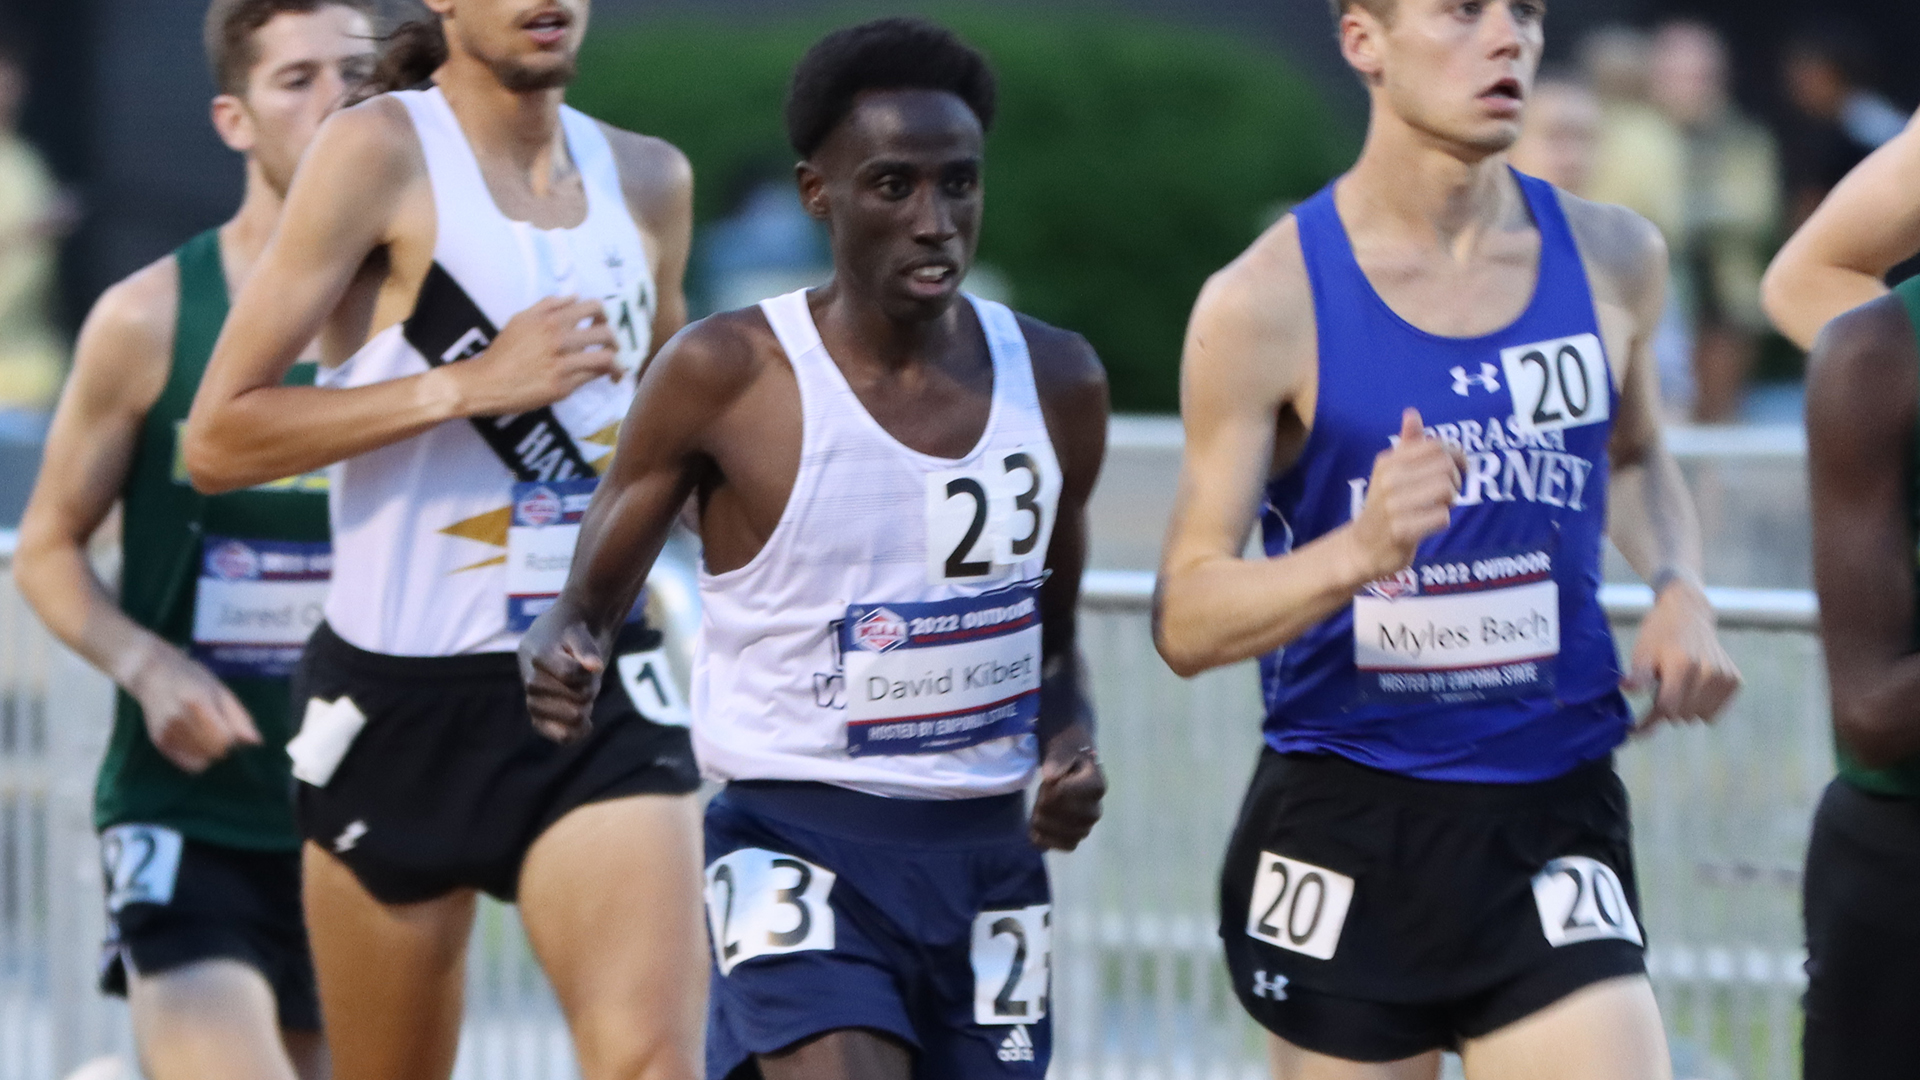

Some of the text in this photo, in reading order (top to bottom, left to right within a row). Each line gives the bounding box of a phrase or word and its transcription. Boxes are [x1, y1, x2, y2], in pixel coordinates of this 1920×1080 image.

[1519, 344, 1589, 425] 20
[1387, 414, 1567, 452] BRASKA
[944, 452, 1042, 578] 23
[1347, 450, 1593, 521] RNEY
[1472, 551, 1551, 581] OUTDOOR
[910, 597, 1036, 636] 2022 OUTDOOR
[1378, 607, 1549, 659] Myles Bach
[867, 667, 954, 702] David
[963, 653, 1034, 692] Kibet
[867, 722, 917, 742] HOSTED
[713, 857, 812, 961] 23
[1257, 861, 1326, 946] 20
[1545, 866, 1624, 932] 20
[991, 911, 1050, 1017] 2
